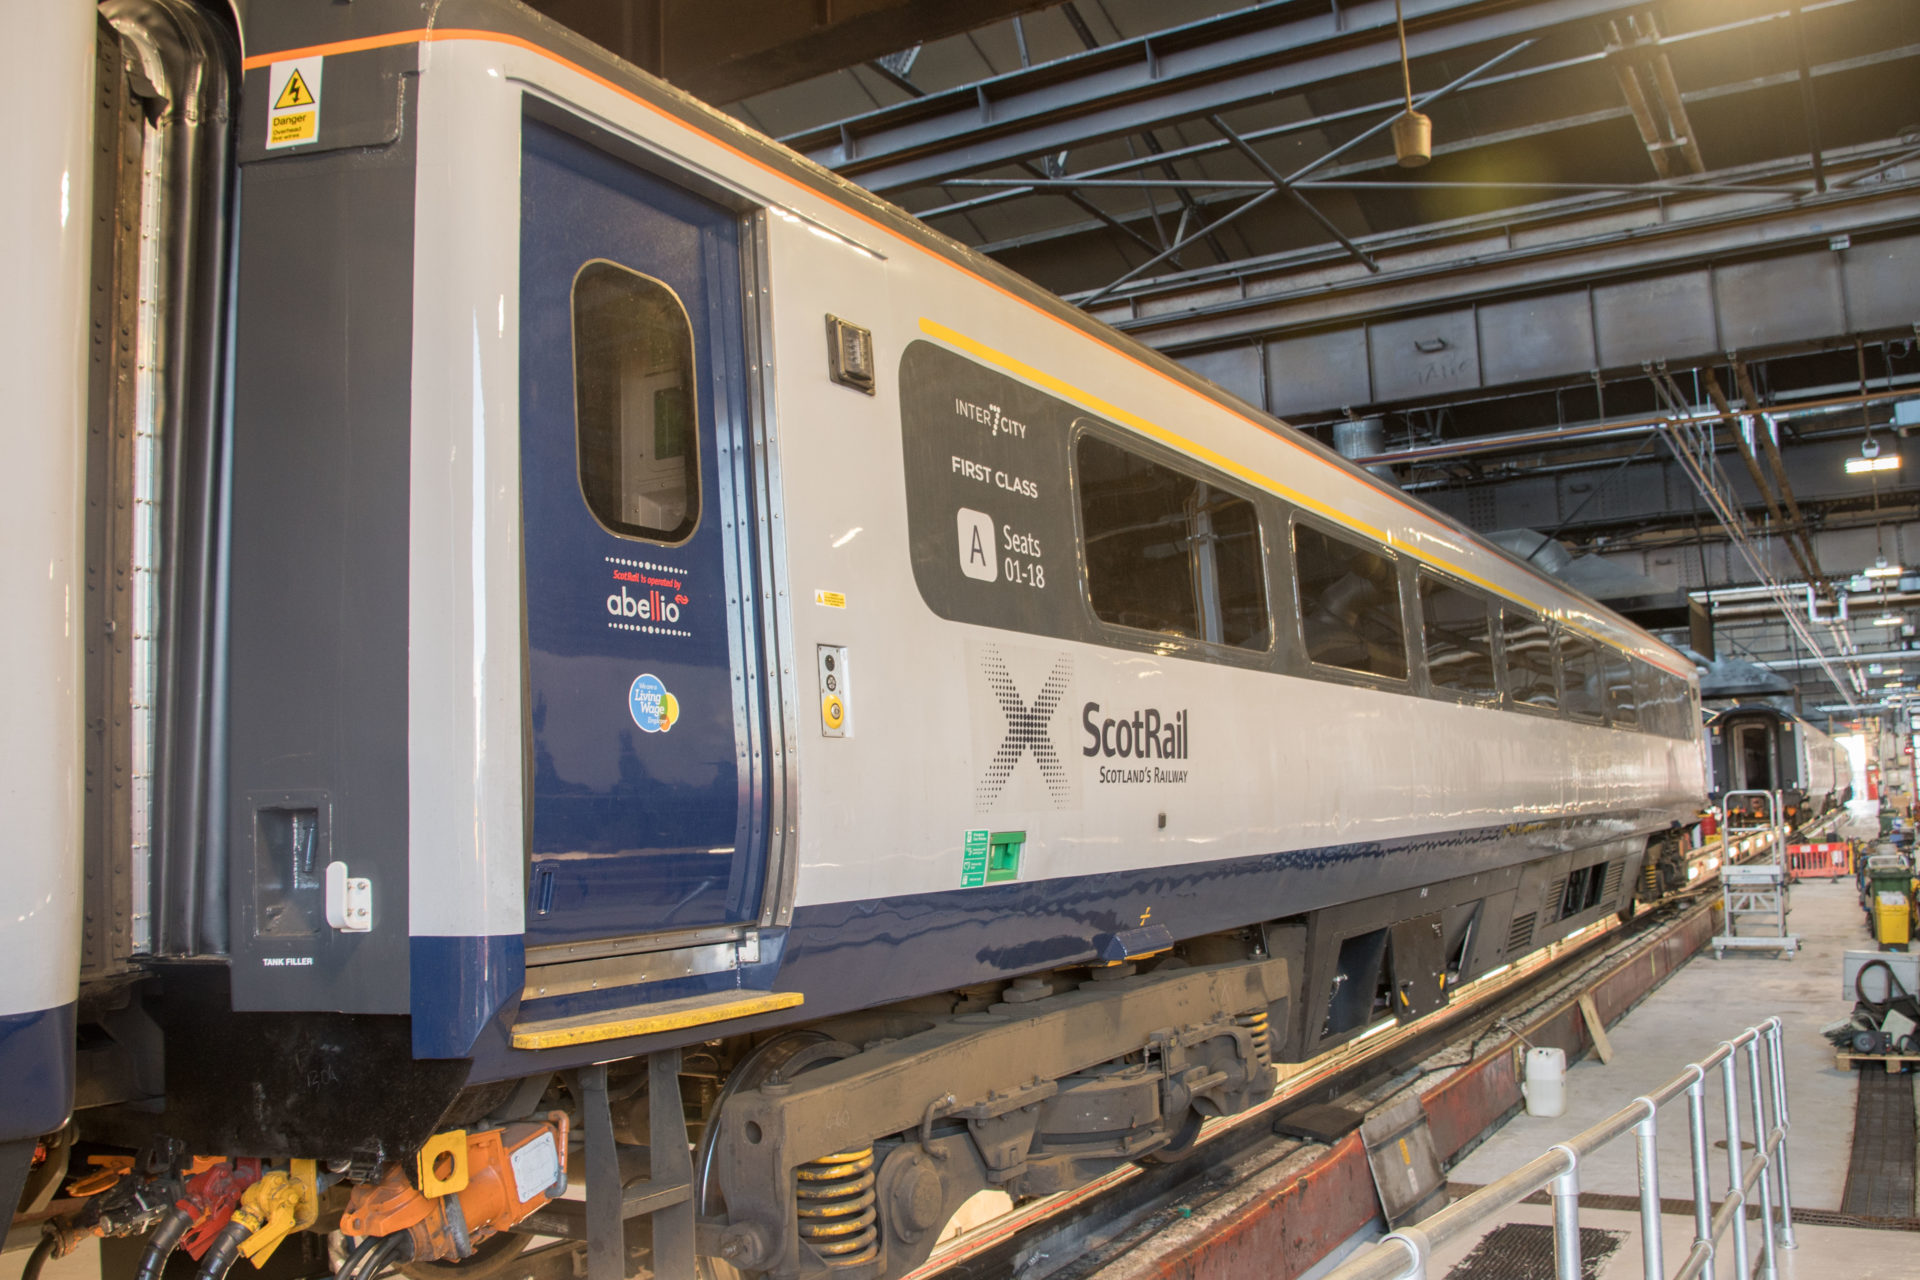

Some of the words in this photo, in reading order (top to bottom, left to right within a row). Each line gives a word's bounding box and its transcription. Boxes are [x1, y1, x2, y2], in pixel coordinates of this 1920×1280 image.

[273, 115, 306, 126] Danger
[951, 455, 991, 483] FIRST
[995, 471, 1038, 499] CLASS
[970, 525, 986, 567] A
[1003, 524, 1041, 558] Seats
[647, 577, 674, 588] operated
[673, 579, 682, 591] by
[1005, 557, 1045, 588] 01-18
[607, 586, 679, 622] abellio
[634, 689, 661, 705] Living
[640, 701, 665, 717] Wage
[1082, 701, 1188, 760] ScotRail
[1099, 766, 1152, 784] SCOTLAND'S
[1153, 767, 1188, 784] RAILWAY
[262, 958, 284, 966] TANK
[285, 957, 314, 966] FILLER
